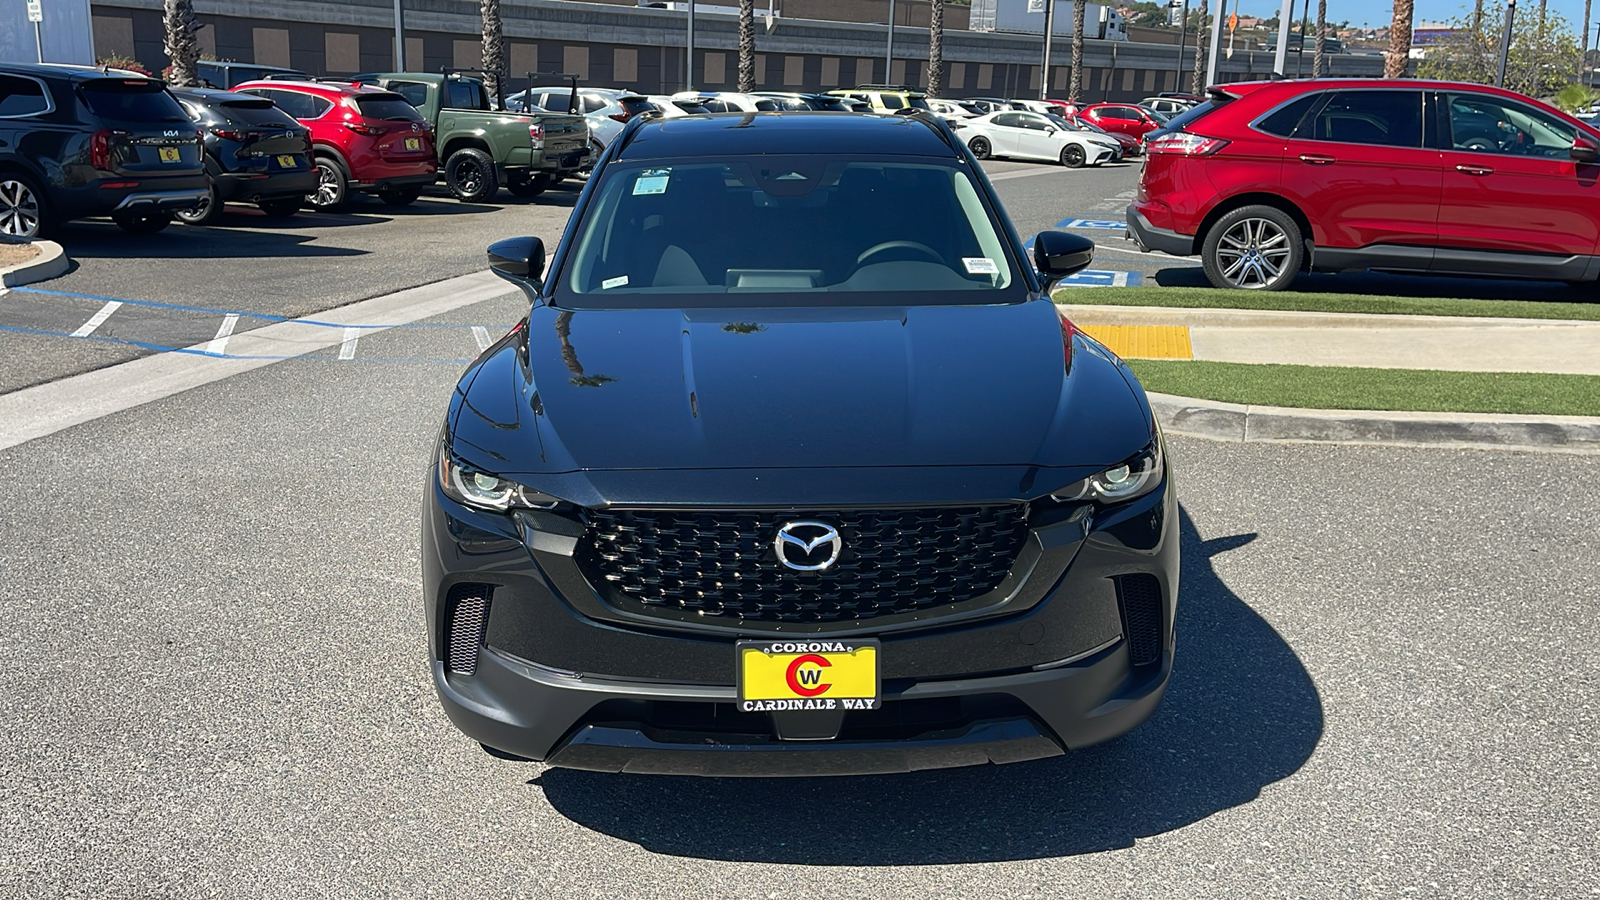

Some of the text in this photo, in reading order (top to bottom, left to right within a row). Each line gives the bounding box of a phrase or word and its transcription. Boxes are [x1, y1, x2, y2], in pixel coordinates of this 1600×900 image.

[771, 642, 846, 653] CORONA
[785, 654, 833, 697] C
[799, 669, 823, 685] W
[743, 698, 876, 711] CARDINALE WAY
